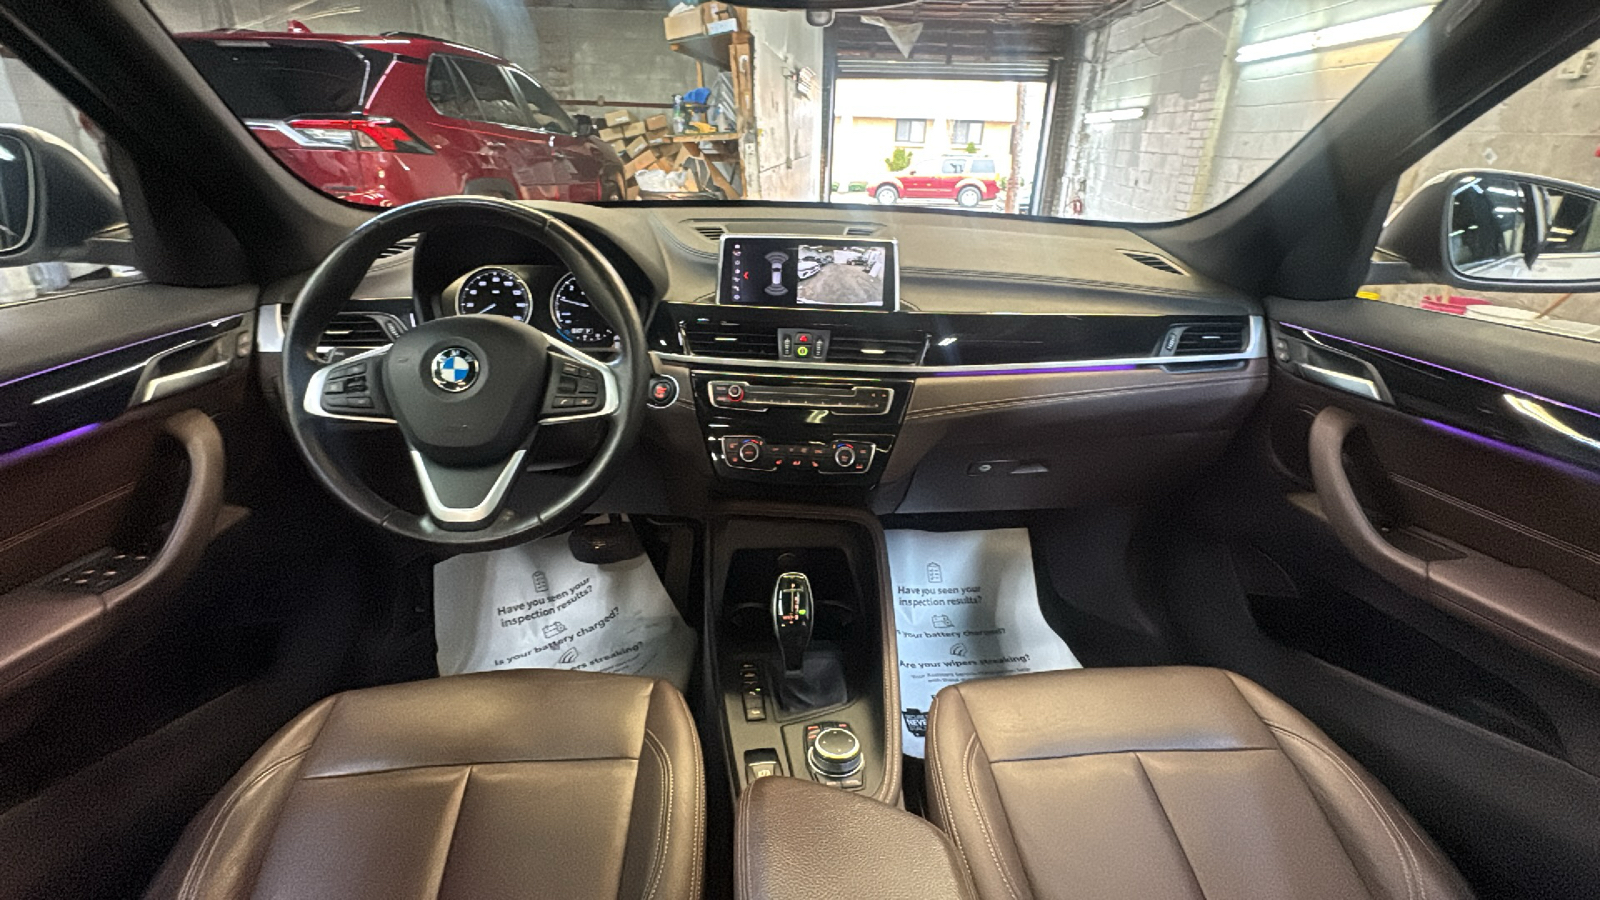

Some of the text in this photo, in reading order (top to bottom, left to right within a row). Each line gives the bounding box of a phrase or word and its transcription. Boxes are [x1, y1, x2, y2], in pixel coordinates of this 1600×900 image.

[497, 577, 591, 616] Have you seen your
[897, 586, 981, 597] Have you seen your
[500, 584, 593, 628] inspection results?
[898, 595, 983, 608] inspection results?
[506, 650, 533, 664] your
[533, 634, 574, 654] battery
[576, 606, 620, 638] charged?
[923, 631, 961, 639] battery
[589, 641, 643, 666] streaking?
[900, 660, 917, 669] Are
[917, 661, 941, 669] your
[942, 659, 979, 668] wipers
